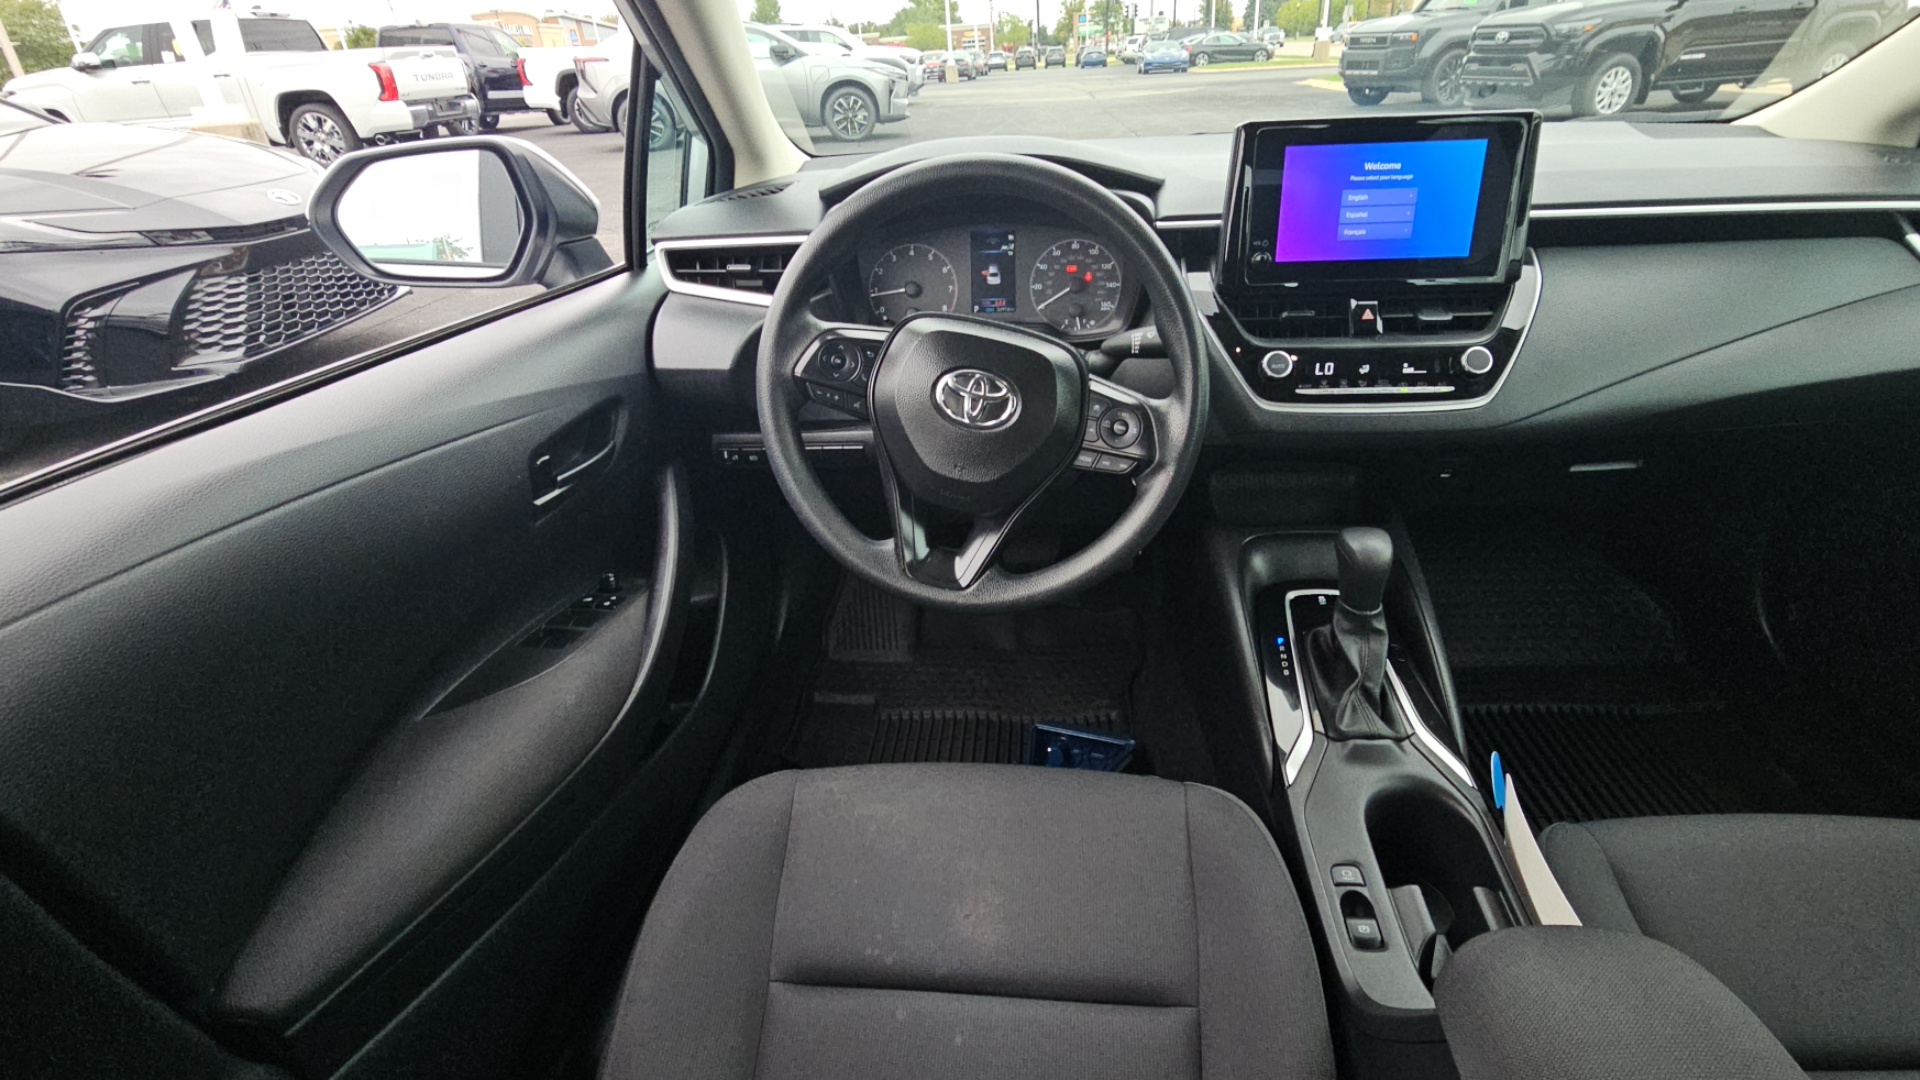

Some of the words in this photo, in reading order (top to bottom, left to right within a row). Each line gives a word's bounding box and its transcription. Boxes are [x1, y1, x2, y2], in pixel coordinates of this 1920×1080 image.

[413, 72, 454, 82] TUNDRA
[1364, 162, 1402, 171] Welcome
[1348, 194, 1369, 202] English
[1346, 211, 1369, 219] Español
[1344, 229, 1367, 237] Français
[1315, 362, 1334, 376] LO
